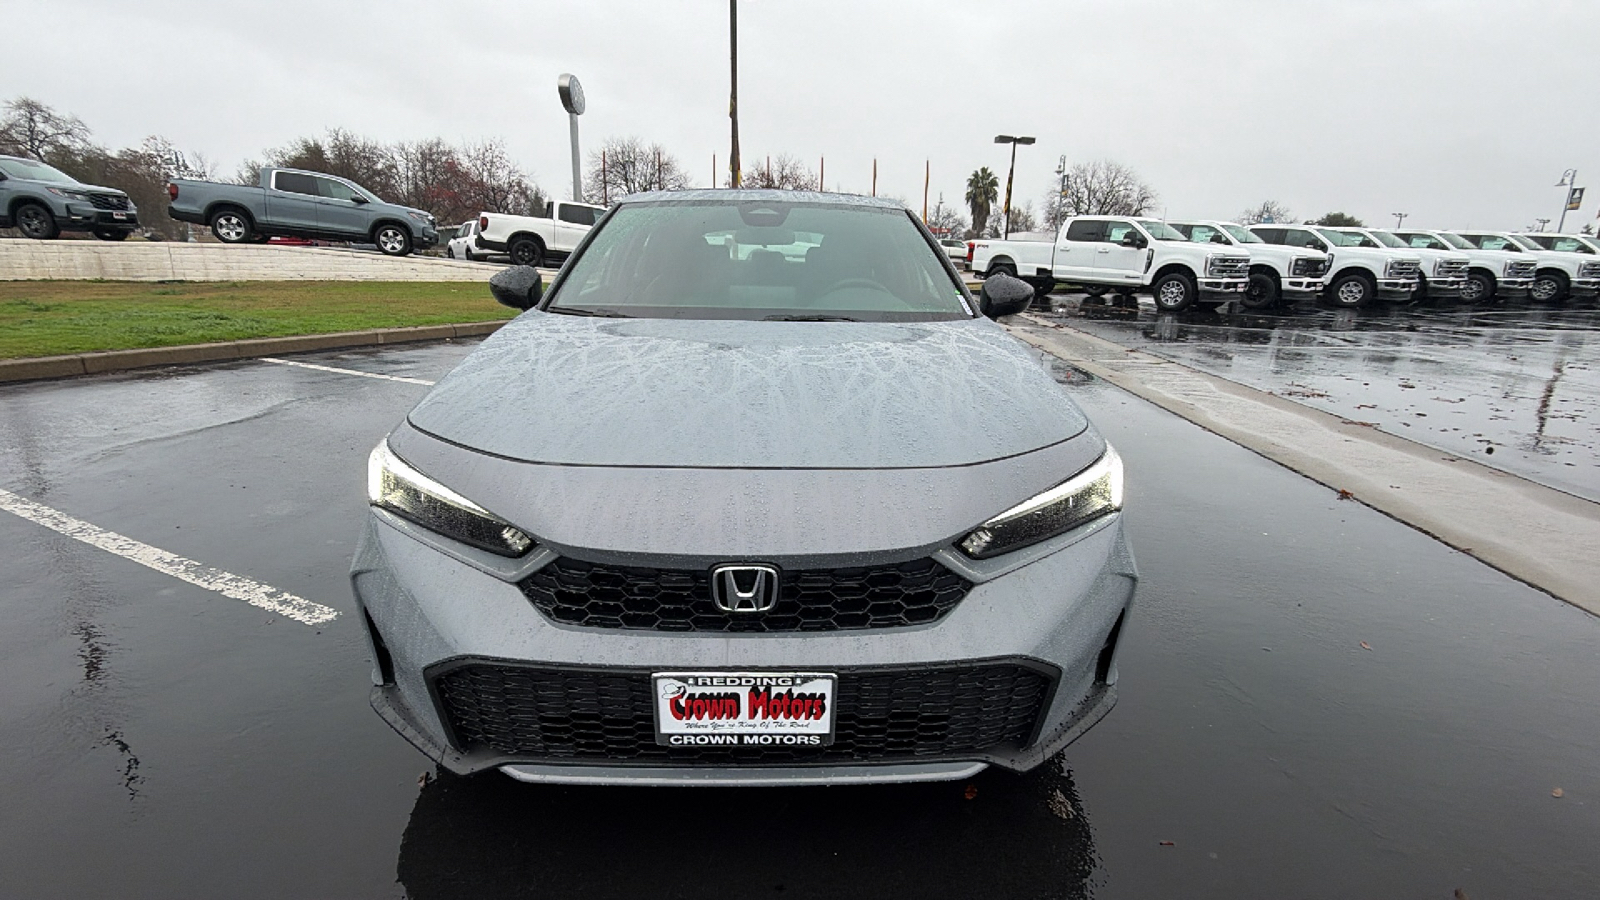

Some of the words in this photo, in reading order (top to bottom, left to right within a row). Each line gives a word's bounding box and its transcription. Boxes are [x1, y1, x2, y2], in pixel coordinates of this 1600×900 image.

[697, 677, 793, 686] REDDING
[669, 685, 741, 721] Crown
[748, 685, 826, 721] Motors
[710, 721, 736, 730] You're
[738, 721, 757, 729] King
[759, 721, 771, 730] Of
[669, 734, 739, 745] CROWN
[743, 734, 821, 745] MOTORS
